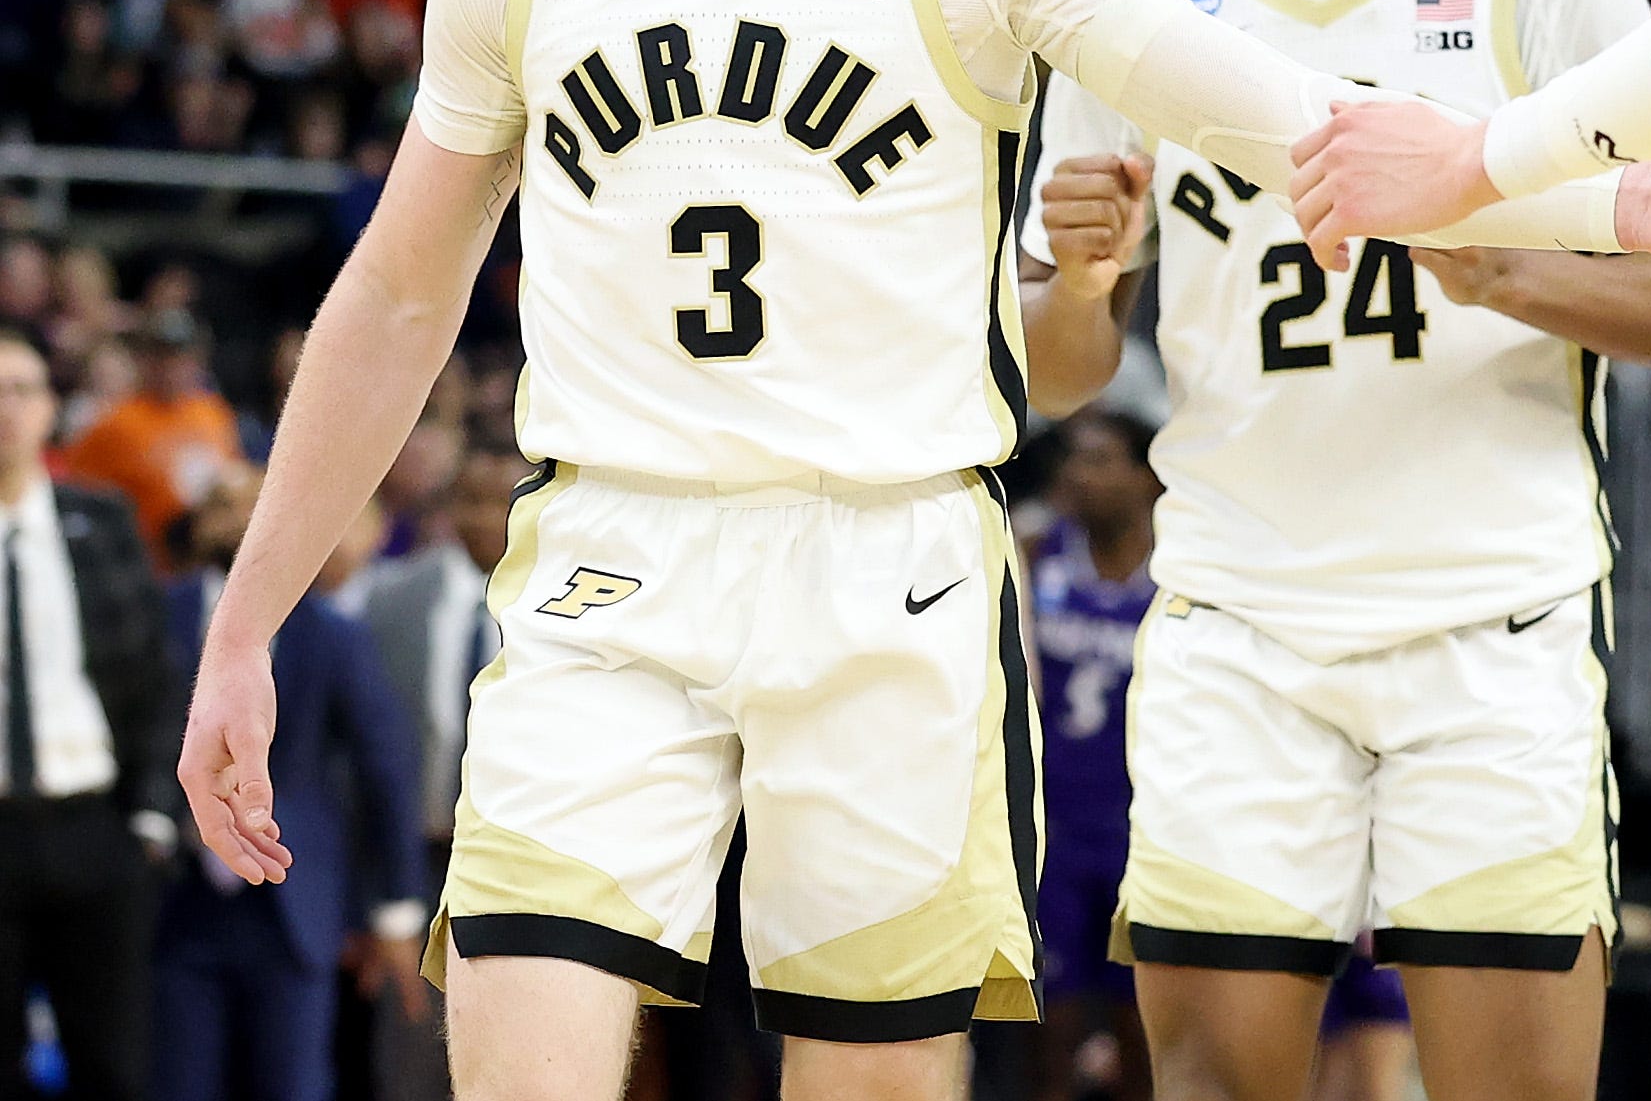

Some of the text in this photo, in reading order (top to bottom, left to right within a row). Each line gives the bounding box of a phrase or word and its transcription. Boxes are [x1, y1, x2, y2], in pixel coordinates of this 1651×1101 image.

[542, 16, 938, 205] PURDUE
[668, 203, 768, 362] 3
[1260, 236, 1428, 376] 24
[535, 566, 642, 618] P
